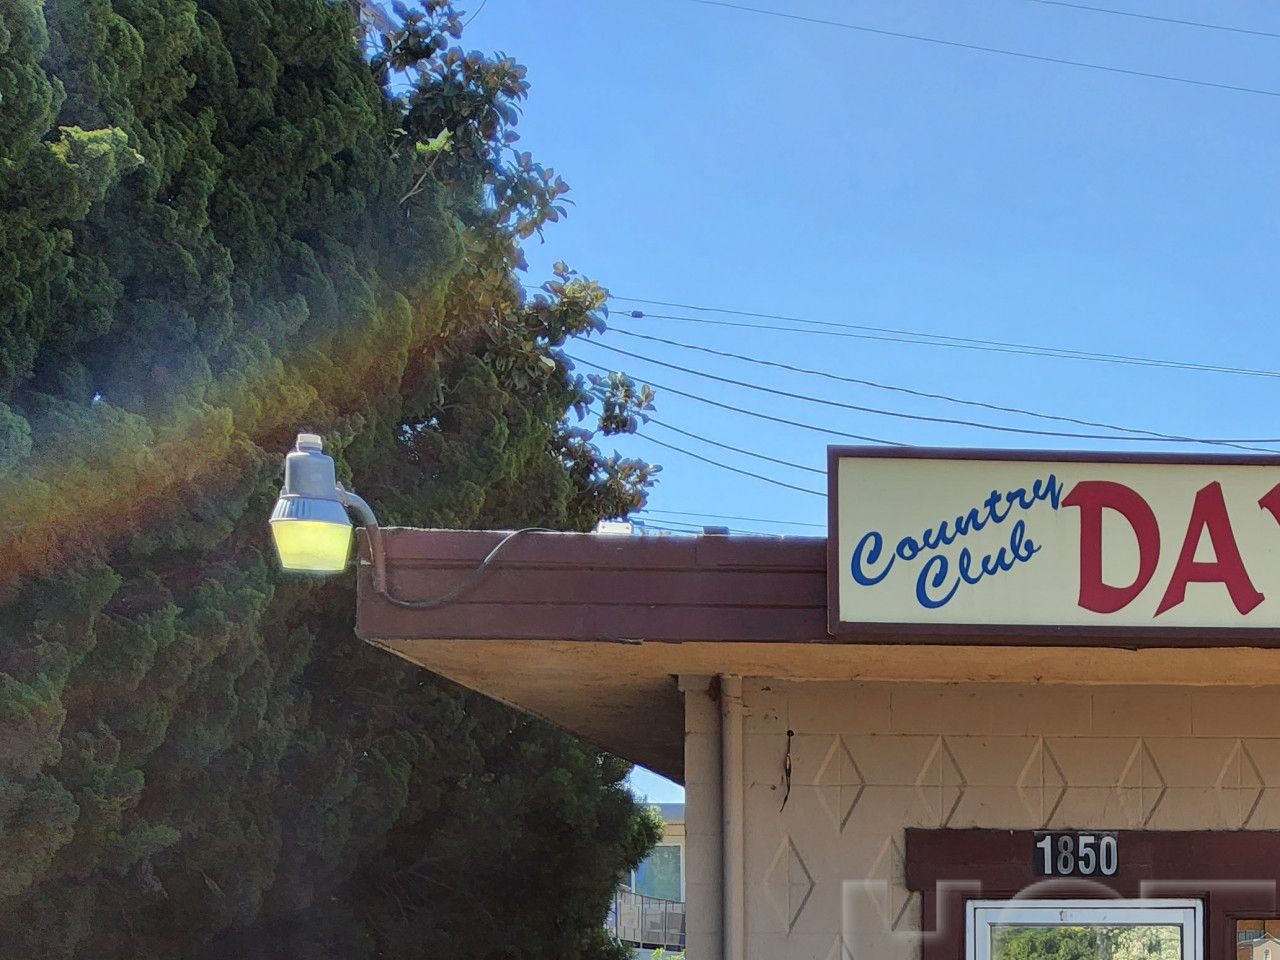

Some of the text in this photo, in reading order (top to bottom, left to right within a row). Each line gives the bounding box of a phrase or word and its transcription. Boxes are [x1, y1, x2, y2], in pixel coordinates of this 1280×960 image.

[851, 474, 1063, 586] Country
[916, 519, 1042, 609] Club
[1036, 835, 1118, 876] 1850
